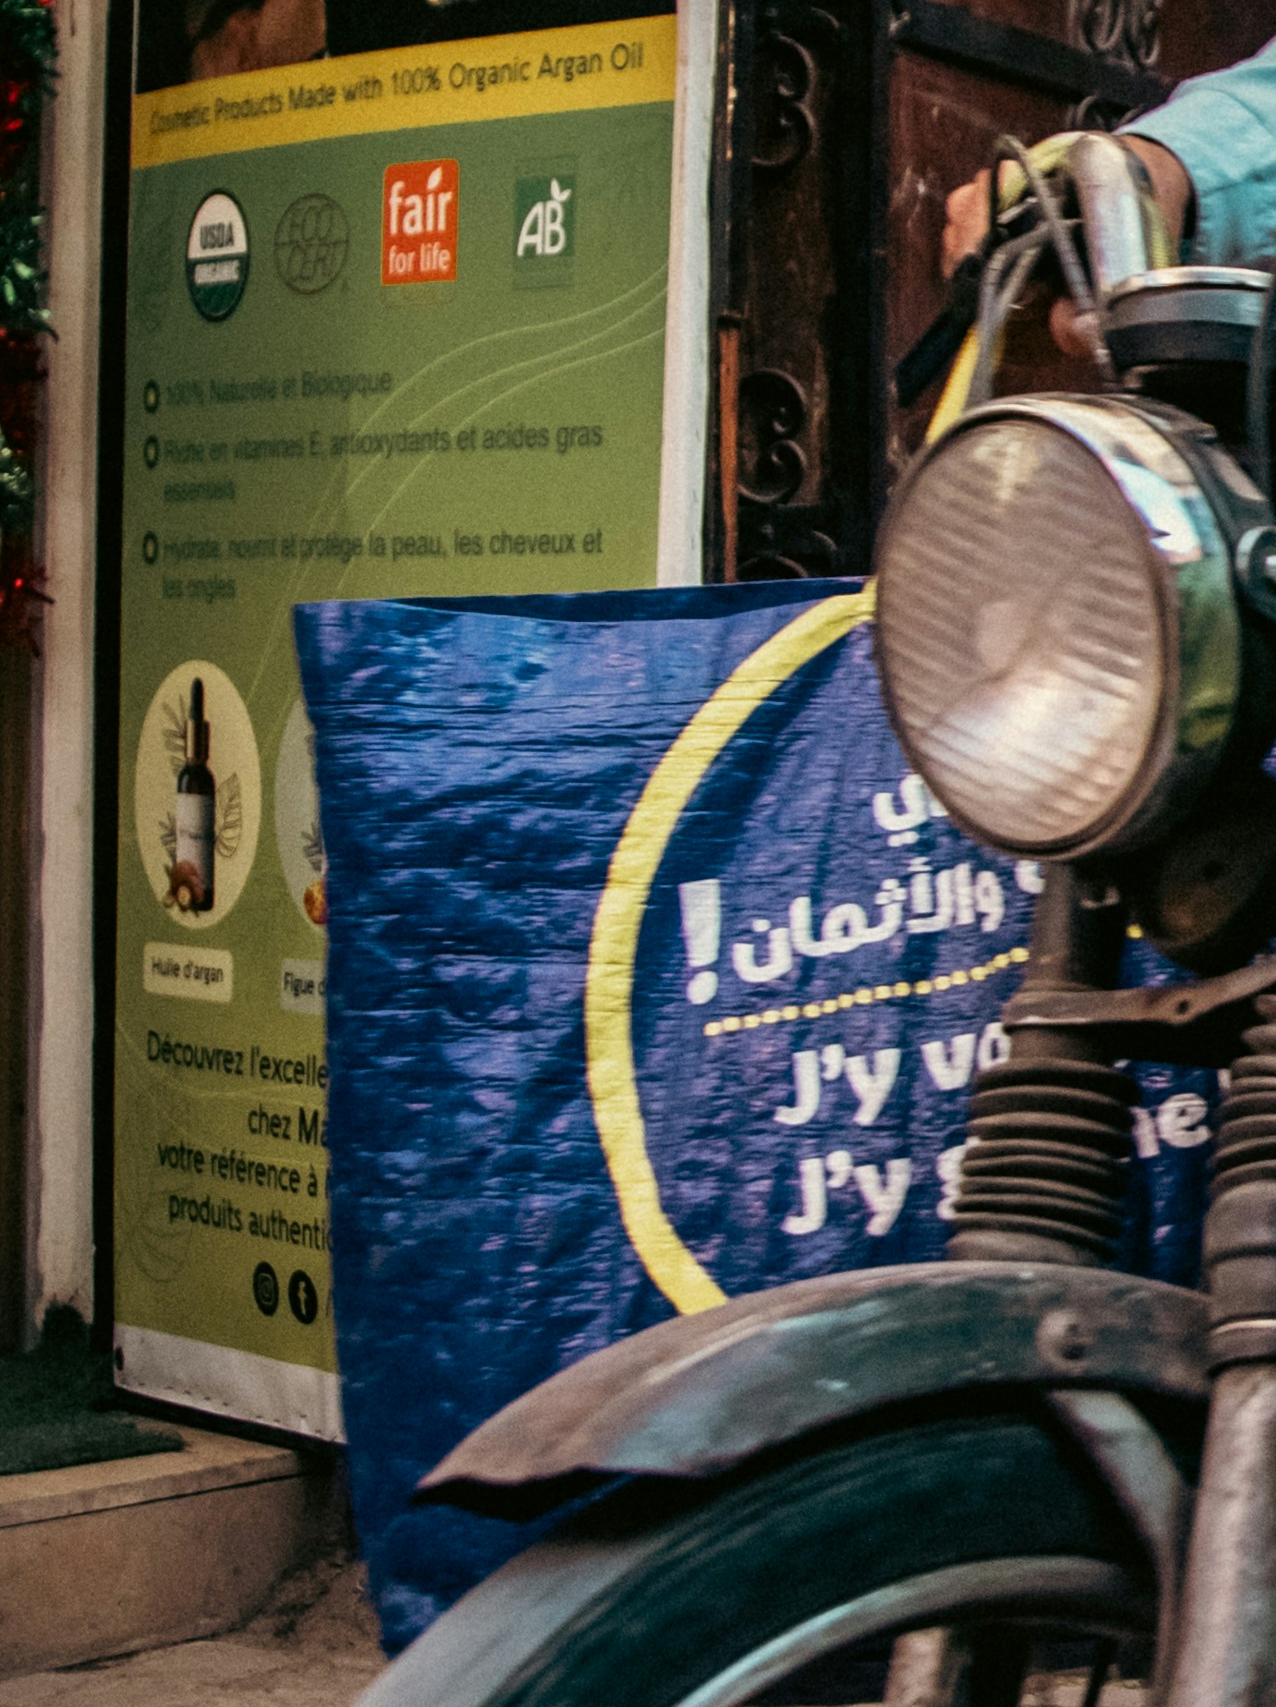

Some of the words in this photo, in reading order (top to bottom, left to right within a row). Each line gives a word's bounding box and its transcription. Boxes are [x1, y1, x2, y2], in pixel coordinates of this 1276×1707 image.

[150, 103, 210, 135] Cosmetic
[214, 92, 282, 121] Products
[288, 82, 336, 111] Made
[342, 73, 383, 102] with
[391, 66, 441, 94] 100%
[449, 56, 531, 92] Organic
[537, 52, 603, 82] Argan
[610, 41, 644, 71] Oil
[389, 167, 453, 236] fair
[200, 222, 235, 250] USDA
[517, 199, 566, 257] AB
[389, 245, 416, 275] for
[420, 242, 450, 273] life
[302, 370, 391, 402] Biologique
[456, 425, 477, 452] et
[482, 422, 549, 451] acides
[555, 424, 603, 454] gras
[300, 532, 363, 563] protège
[368, 531, 386, 557] la
[392, 533, 447, 561] peau,
[453, 529, 484, 556] les
[489, 528, 576, 555] cheveux
[581, 528, 603, 554] et
[162, 576, 183, 599] les
[186, 575, 236, 604] ongles
[151, 956, 180, 979] Huile
[183, 960, 224, 985] d'argan
[283, 971, 315, 996] Figue
[146, 1029, 244, 1075] Découvrez
[250, 1045, 328, 1089] l'excelle
[773, 1043, 901, 1127] J'y
[248, 1102, 291, 1140] chez
[157, 1140, 205, 1174] votre
[210, 1146, 301, 1194] référence
[306, 1163, 318, 1197] à
[781, 1149, 912, 1237] J'y
[168, 1193, 243, 1233] produits
